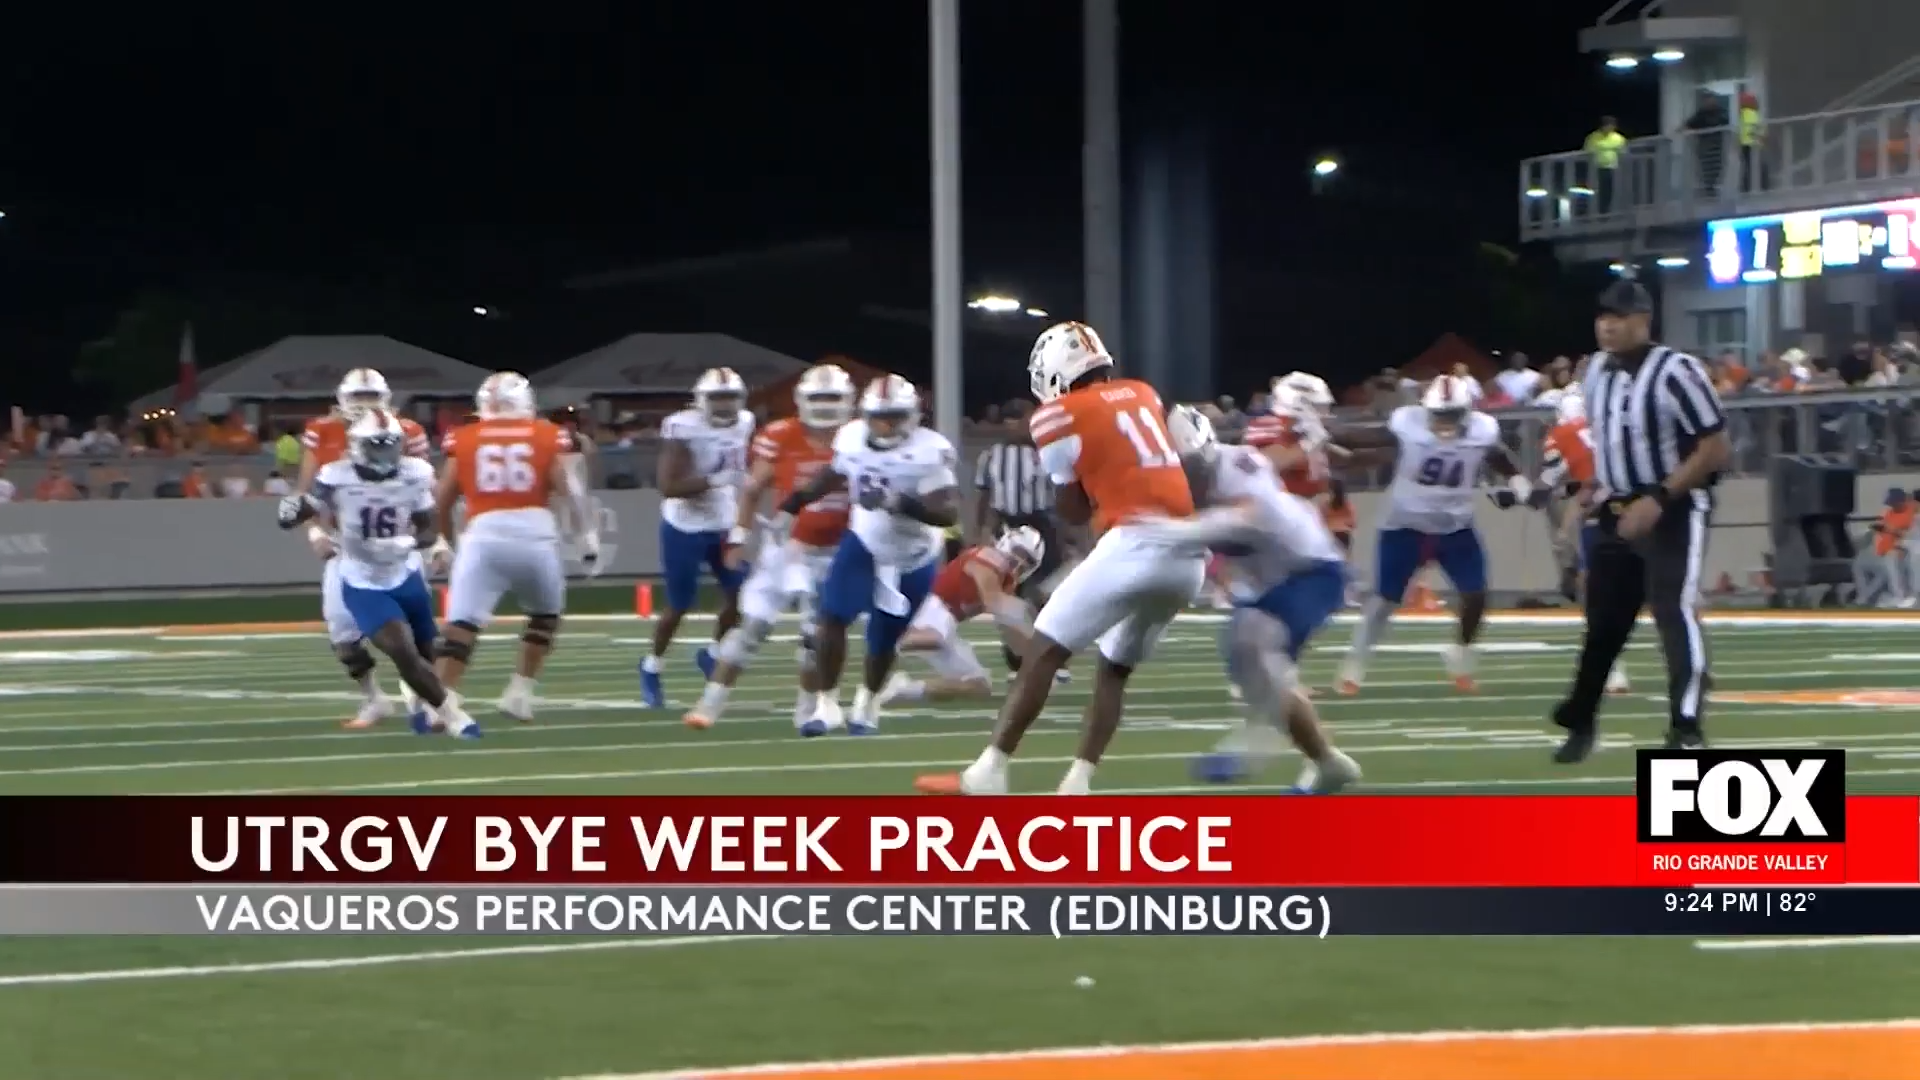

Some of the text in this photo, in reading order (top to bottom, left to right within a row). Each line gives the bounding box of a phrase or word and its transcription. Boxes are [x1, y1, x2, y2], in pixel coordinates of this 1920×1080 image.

[1116, 406, 1181, 468] 11
[476, 443, 536, 492] 66
[359, 505, 397, 540] 16
